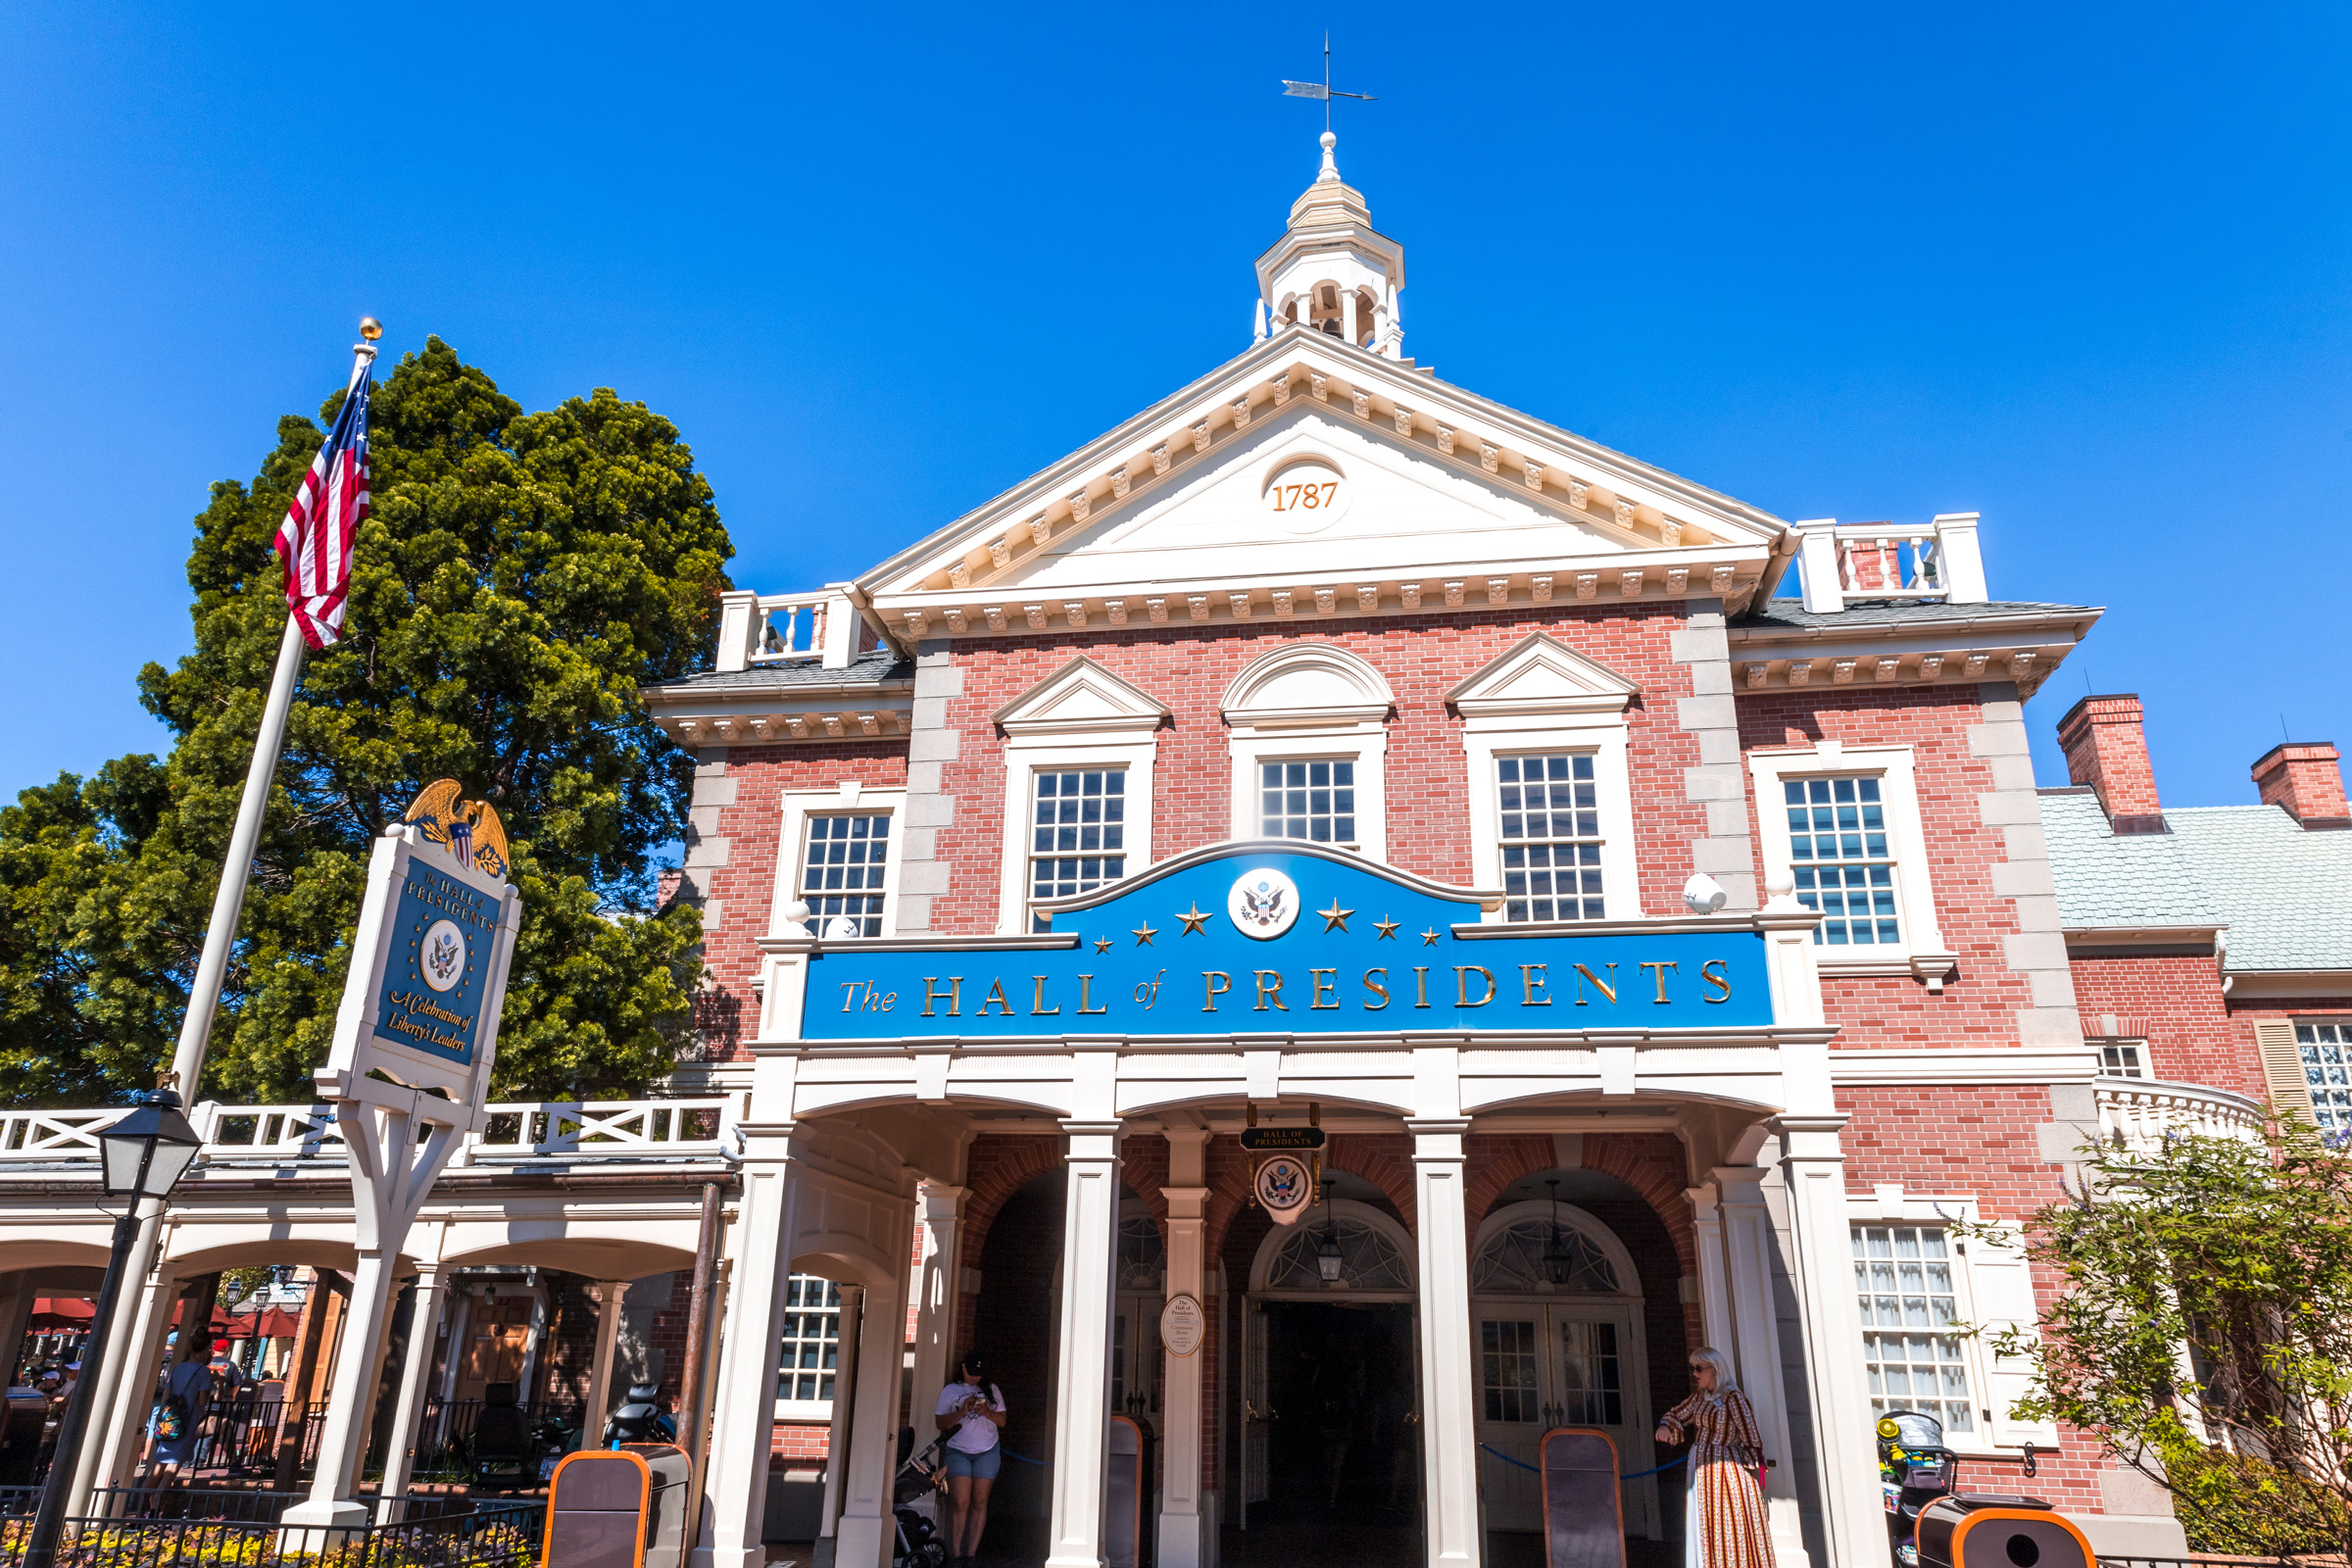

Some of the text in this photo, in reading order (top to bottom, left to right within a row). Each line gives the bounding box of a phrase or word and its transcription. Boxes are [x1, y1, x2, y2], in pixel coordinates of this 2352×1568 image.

[1272, 481, 1339, 513] 1787
[407, 881, 494, 933] PRESIDENTS
[424, 871, 438, 887] The
[440, 878, 474, 906] HALL
[839, 958, 1734, 1018] The HALL of PRESIDENTS
[388, 1011, 466, 1052] Liberty's Leaders
[391, 991, 474, 1033] A Celebration of
